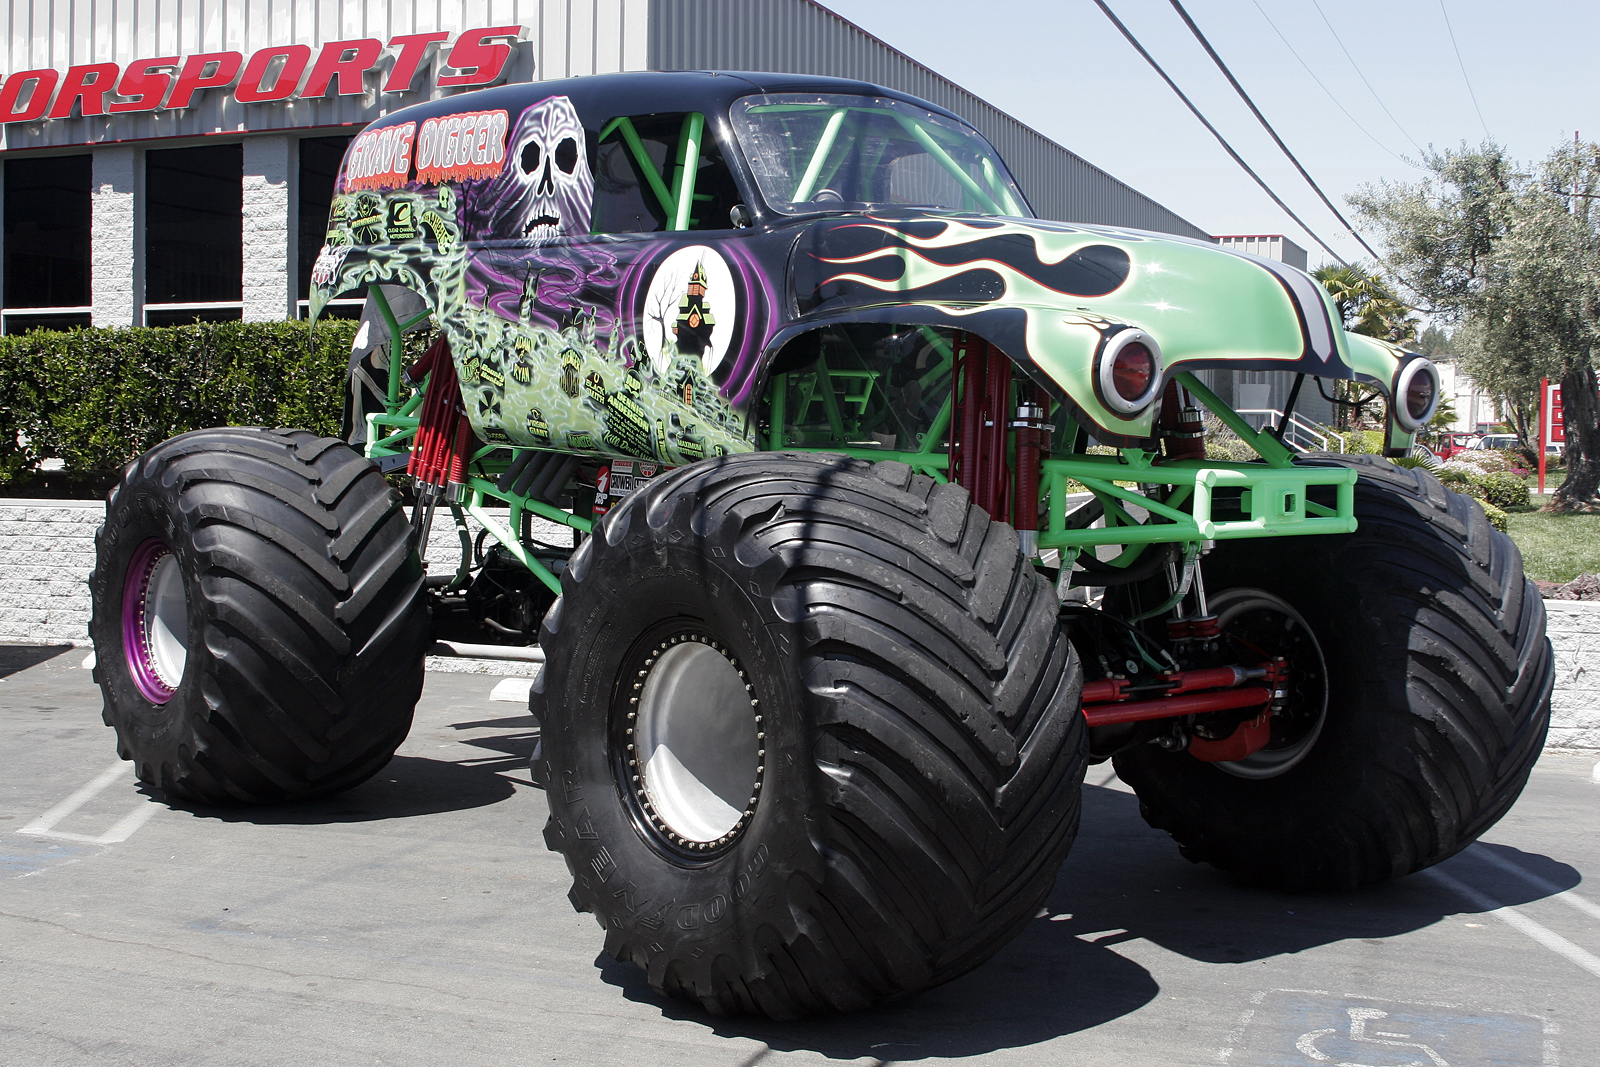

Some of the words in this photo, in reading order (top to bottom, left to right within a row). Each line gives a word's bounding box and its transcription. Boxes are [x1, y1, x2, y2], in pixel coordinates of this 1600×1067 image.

[0, 26, 530, 123] ORSPORTS
[346, 124, 416, 182] GRAVE
[417, 113, 507, 170] DIGGER
[514, 336, 532, 354] ADAM
[480, 363, 505, 383] Bounty
[480, 371, 504, 387] Hunter
[513, 363, 531, 383] RYAN
[585, 378, 605, 396] BLACK
[607, 395, 650, 433] ANDERSON
[616, 391, 645, 418] DENNIS
[529, 426, 548, 438] GIANT
[603, 430, 621, 447] Kill
[620, 440, 640, 456] Devil
[677, 440, 702, 452] MAXIMUM
[610, 474, 633, 491] CROWER
[596, 492, 608, 500] SPEED
[561, 765, 770, 932] GOODYEAR
